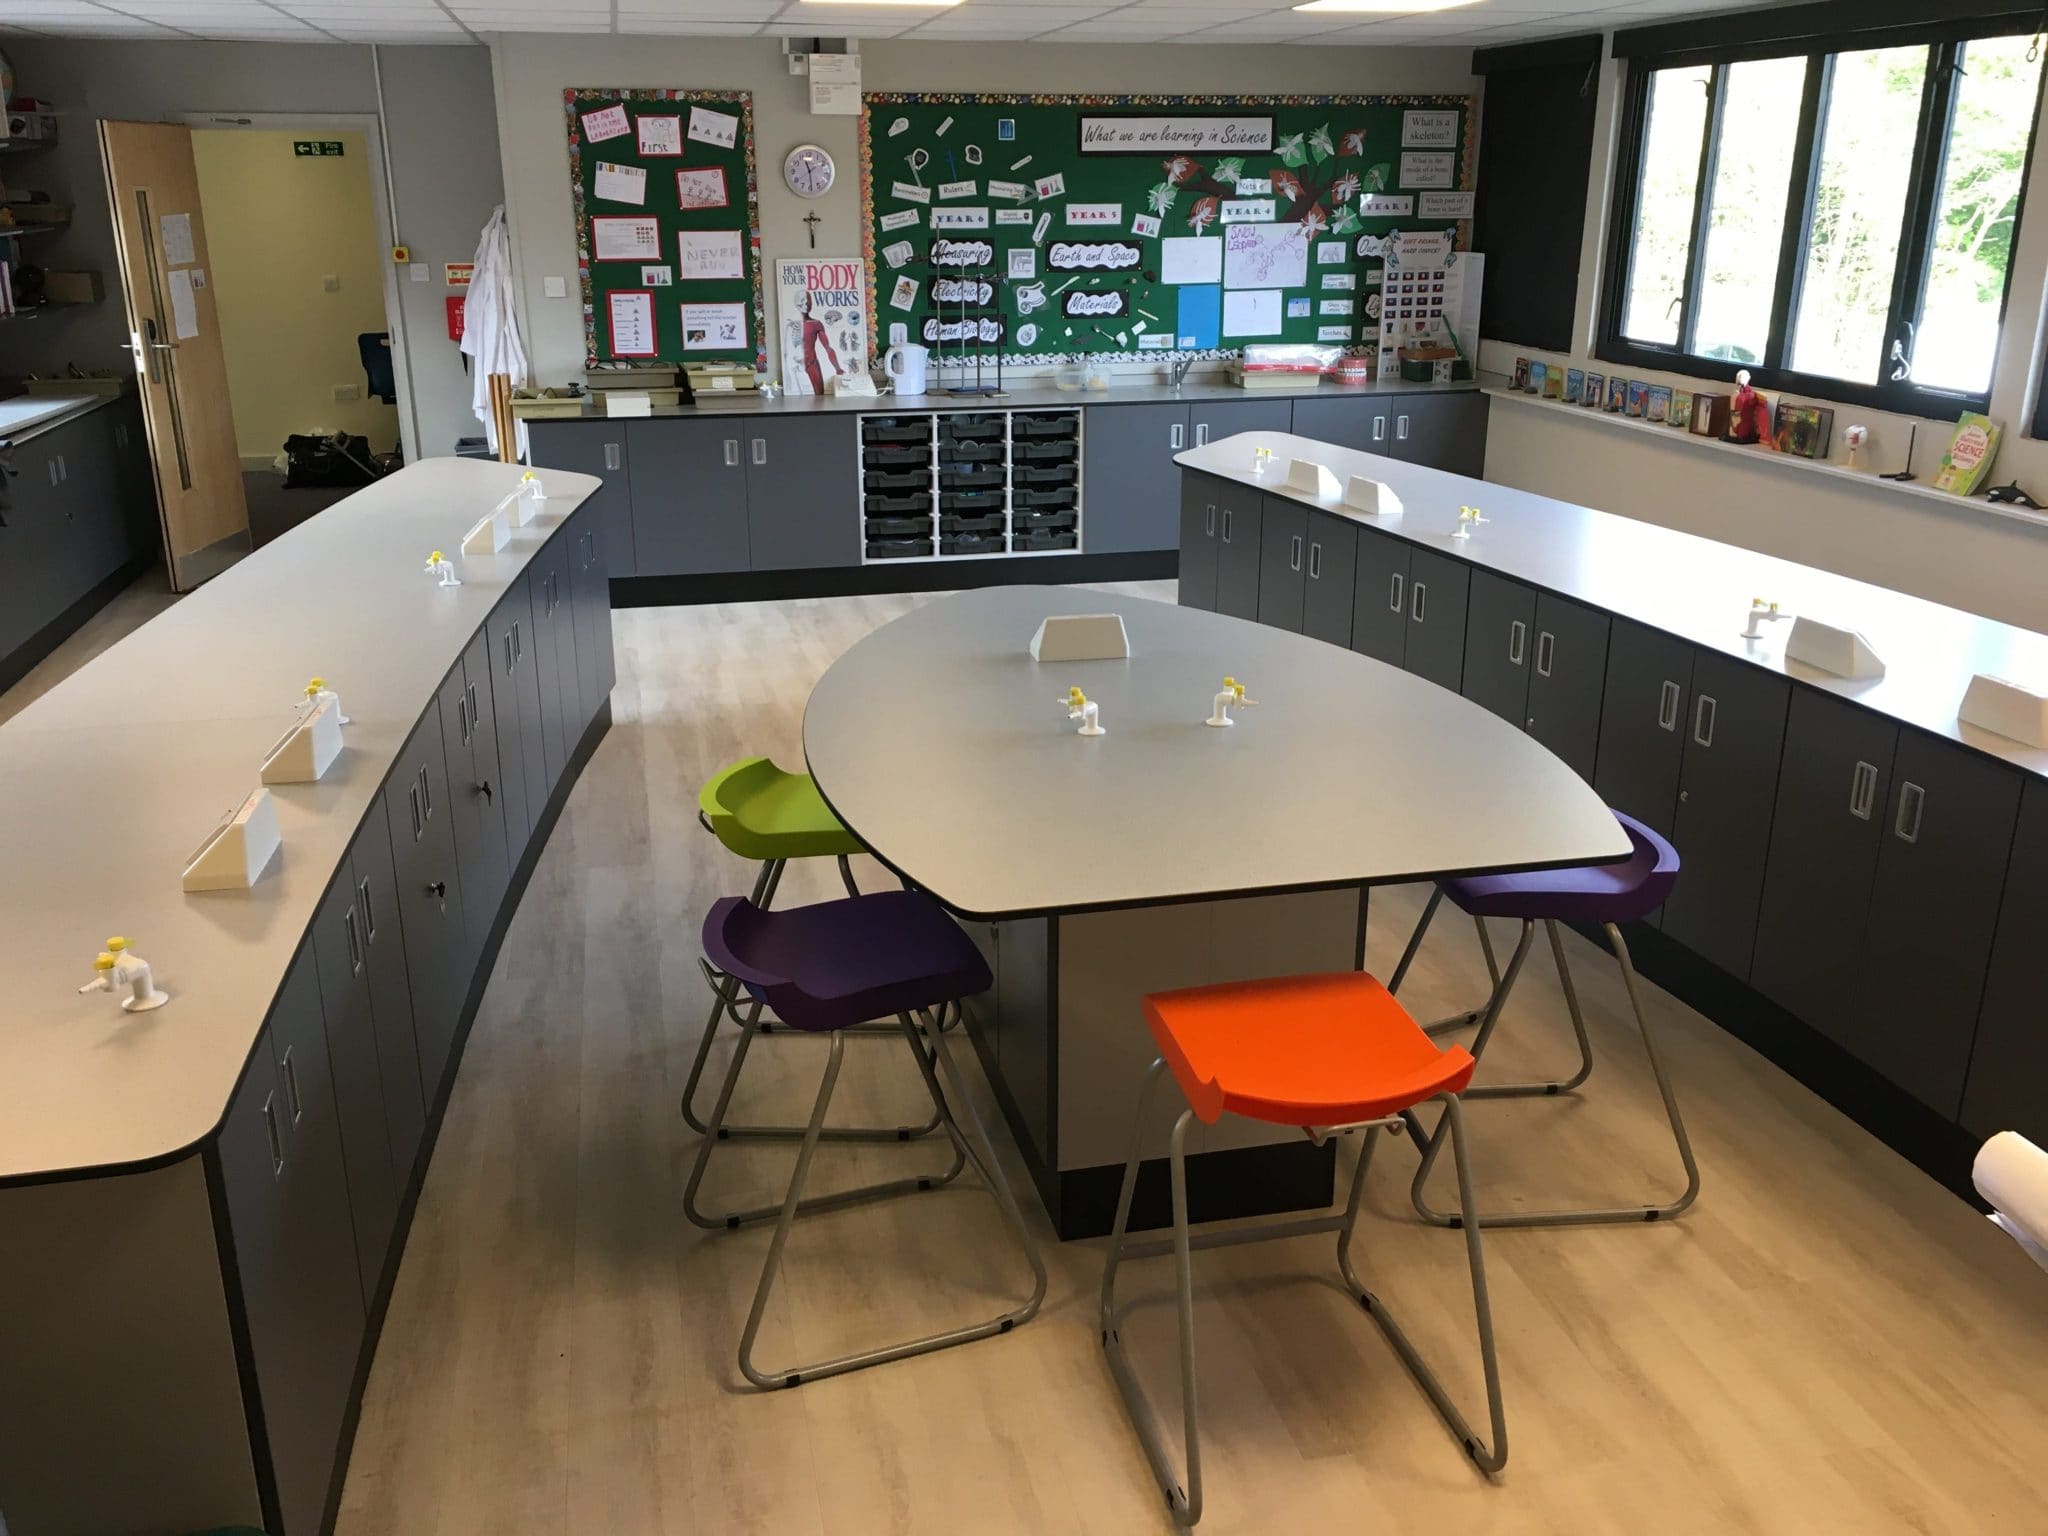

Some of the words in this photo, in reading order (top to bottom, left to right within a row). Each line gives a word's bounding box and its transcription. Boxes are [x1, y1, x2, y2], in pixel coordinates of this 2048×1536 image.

[1411, 117, 1435, 126] What
[1436, 117, 1443, 126] is
[1084, 124, 1115, 143] What
[1119, 132, 1134, 142] we
[1139, 132, 1158, 142] are
[1160, 124, 1204, 147] learning
[1208, 128, 1219, 141] in
[1221, 123, 1268, 144] Science
[1410, 130, 1449, 140] skeleton?
[641, 141, 669, 153] First
[943, 185, 964, 194] Rulers
[1226, 207, 1261, 215] YEAR
[1264, 207, 1271, 215] 4
[1366, 202, 1400, 210] YEAR
[937, 215, 973, 223] YEAR
[1071, 211, 1106, 219] YEAR
[1112, 211, 1117, 219] 5
[1359, 238, 1378, 254] Our
[1051, 247, 1082, 262] Earth
[1085, 247, 1104, 261] and
[1107, 246, 1137, 266] Space
[783, 265, 804, 275] HOW
[782, 275, 806, 286] YOUR
[805, 264, 859, 291] BODY
[813, 290, 859, 308] WORKS
[1069, 294, 1119, 311] Materials
[1953, 441, 1985, 459] SCIENCE
